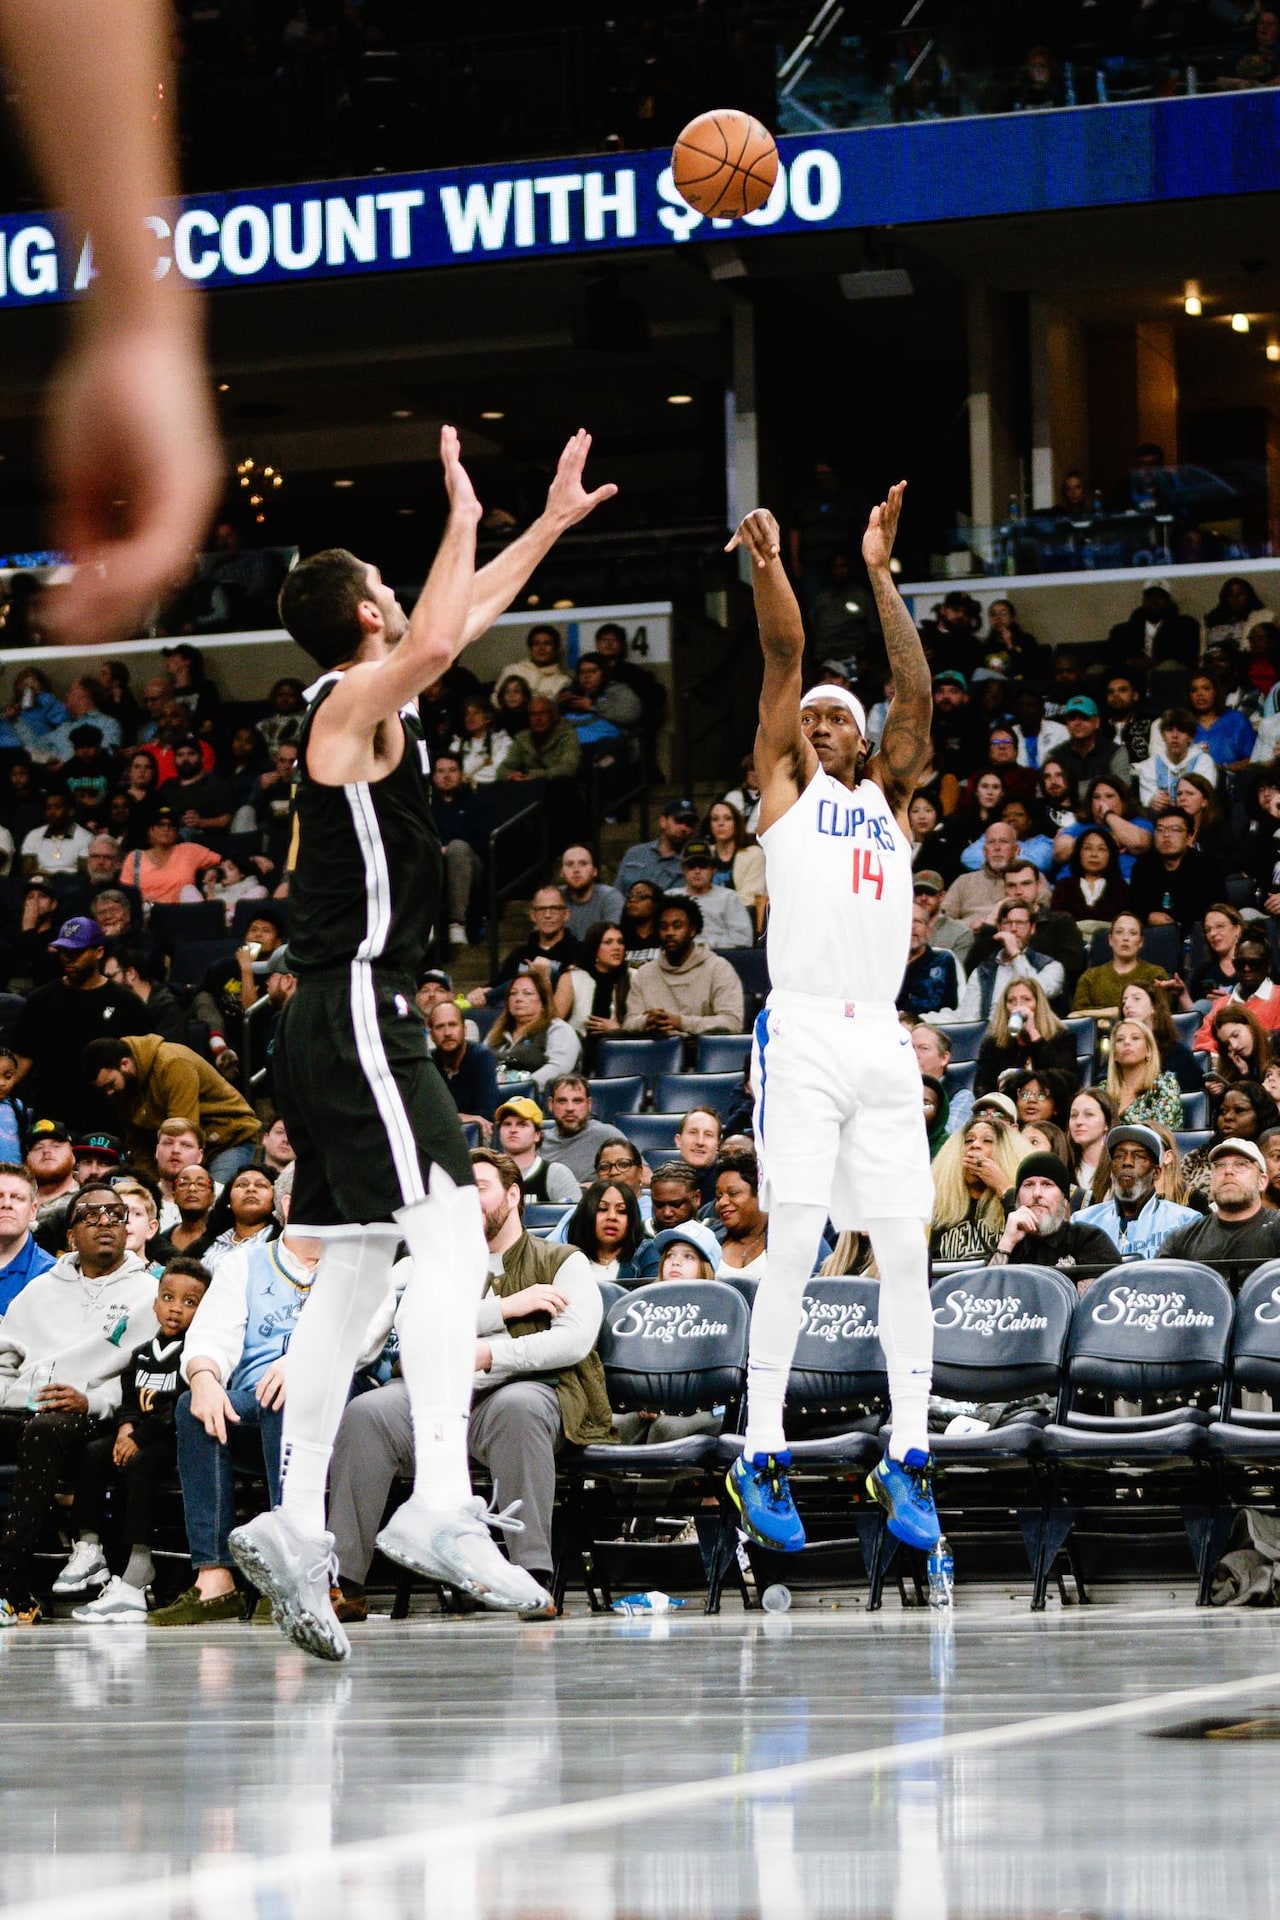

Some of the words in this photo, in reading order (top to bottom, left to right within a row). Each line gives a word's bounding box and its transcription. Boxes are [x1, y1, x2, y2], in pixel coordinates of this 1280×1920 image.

[0, 226, 58, 298] G
[440, 168, 637, 254] WITH
[852, 847, 884, 901] 14
[611, 1299, 701, 1338] Sissy's
[932, 1289, 1021, 1329] Sissy's
[960, 1313, 998, 1337] Log
[997, 1312, 1049, 1331] Cabin
[1091, 1286, 1186, 1325] Sissy's
[1123, 1307, 1161, 1332] Log
[1160, 1308, 1216, 1328] Cabin
[641, 1320, 677, 1343] Log
[677, 1319, 729, 1339] Cabin
[805, 1318, 841, 1343] Log
